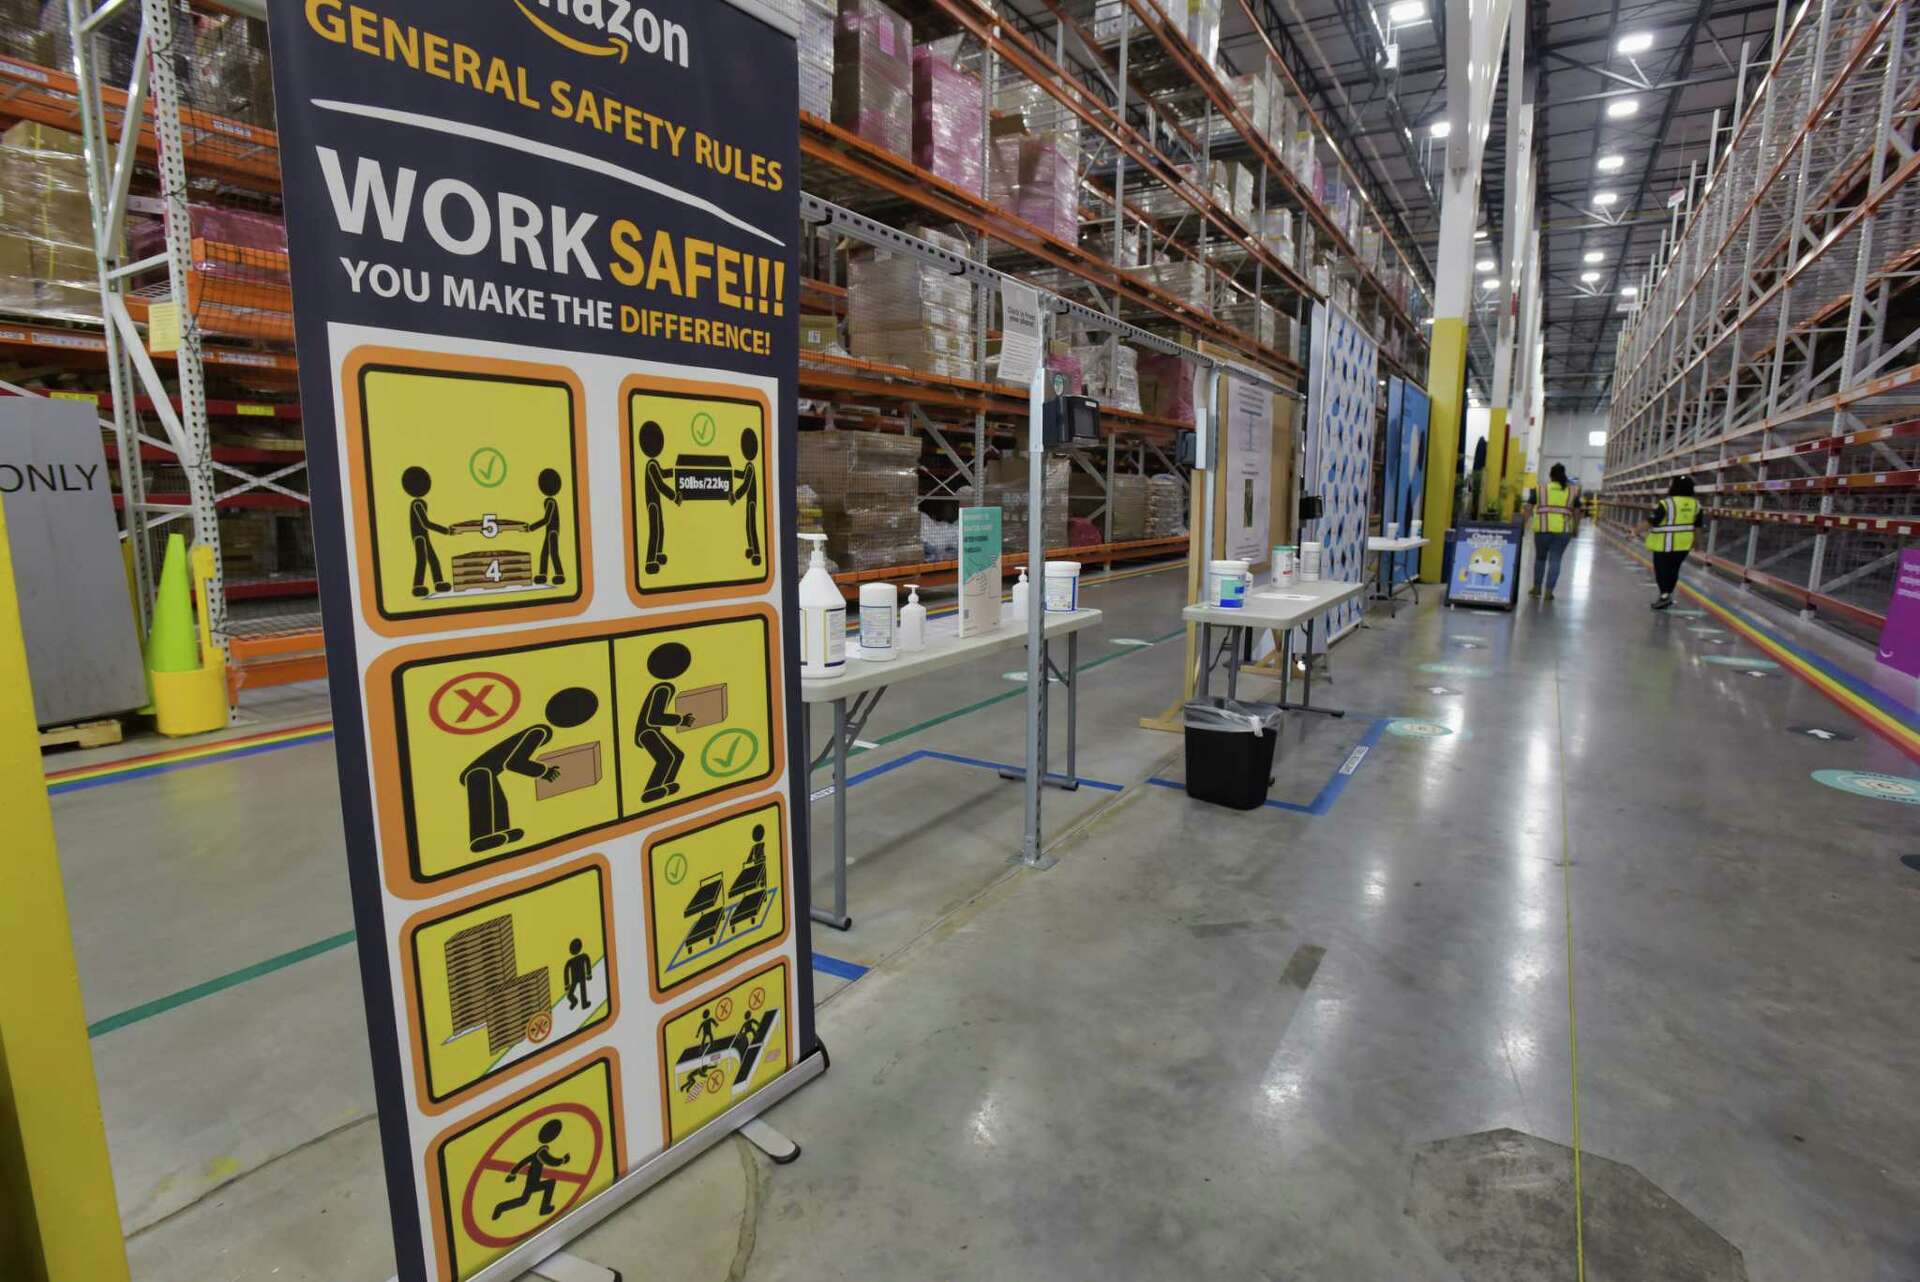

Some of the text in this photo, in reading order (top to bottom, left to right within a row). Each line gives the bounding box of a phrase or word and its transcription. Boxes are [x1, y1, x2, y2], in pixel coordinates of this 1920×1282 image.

[304, 0, 784, 192] GENERAL SAFETY RULES
[315, 145, 786, 317] WORK SAFE!!!
[339, 256, 771, 356] YOU MAKE THE DIFFERENCE!
[0, 464, 98, 493] ONLY
[678, 475, 730, 492] 50lbs/22kg
[481, 513, 499, 538] 5
[485, 560, 501, 583] 4
